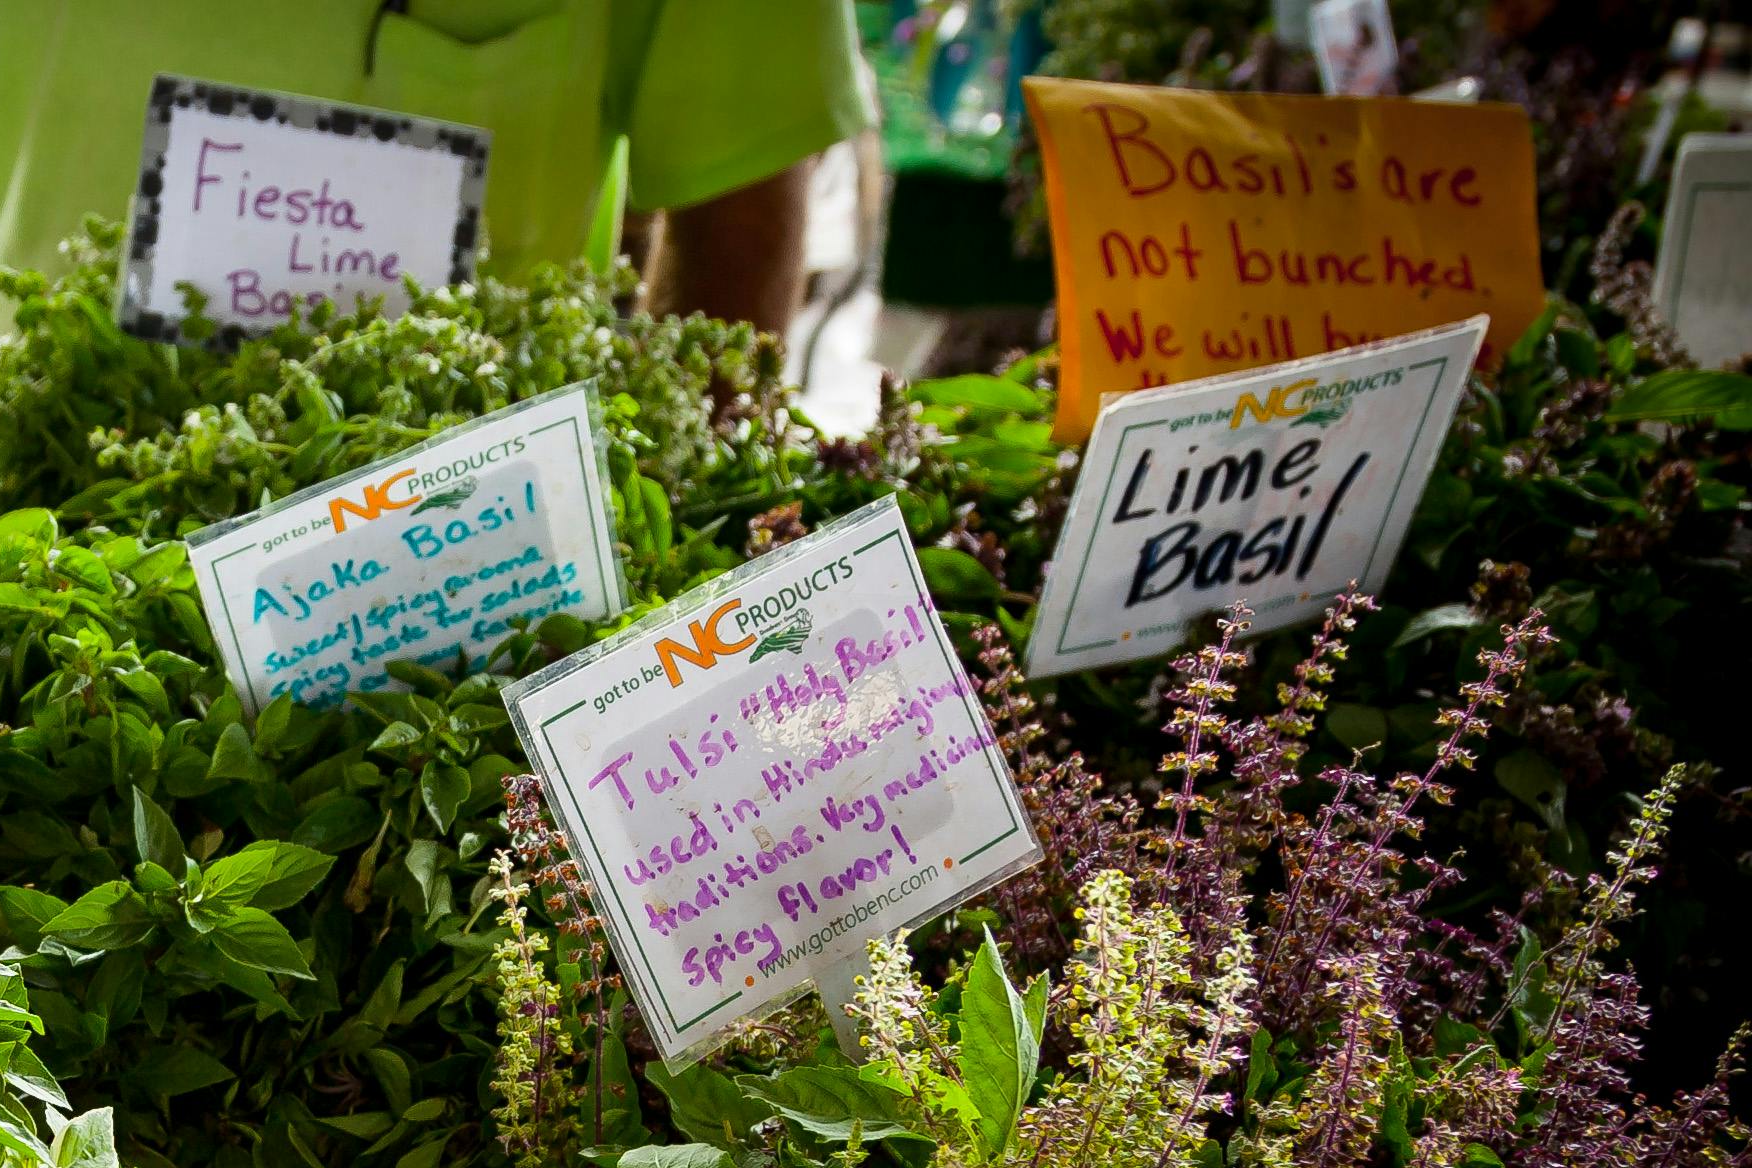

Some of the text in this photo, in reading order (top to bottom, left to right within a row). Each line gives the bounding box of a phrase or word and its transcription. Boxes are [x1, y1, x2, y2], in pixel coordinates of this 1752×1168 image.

[192, 136, 366, 232] Fiesta
[1086, 102, 1484, 206] Basil's are
[289, 232, 401, 283] Lime
[1099, 218, 1494, 298] not bunched.
[1094, 310, 1185, 363] We
[1201, 311, 1296, 363] will
[1230, 377, 1319, 431] NC
[1300, 366, 1405, 407] PRODUCTS
[262, 436, 527, 554] got to be NC PRODUCTS
[401, 480, 538, 561] Basil
[1110, 436, 1323, 525] Lime
[1124, 451, 1372, 609] Basil
[592, 684, 624, 715] got
[621, 677, 641, 694] to
[639, 663, 665, 684] be
[653, 597, 758, 689] NC
[734, 555, 855, 636] PRODUCTS
[588, 712, 738, 811] Tulsi
[623, 809, 719, 887] used
[714, 799, 762, 834] in
[776, 822, 919, 923] flavor!
[758, 862, 941, 980] www.gottobenc.com
